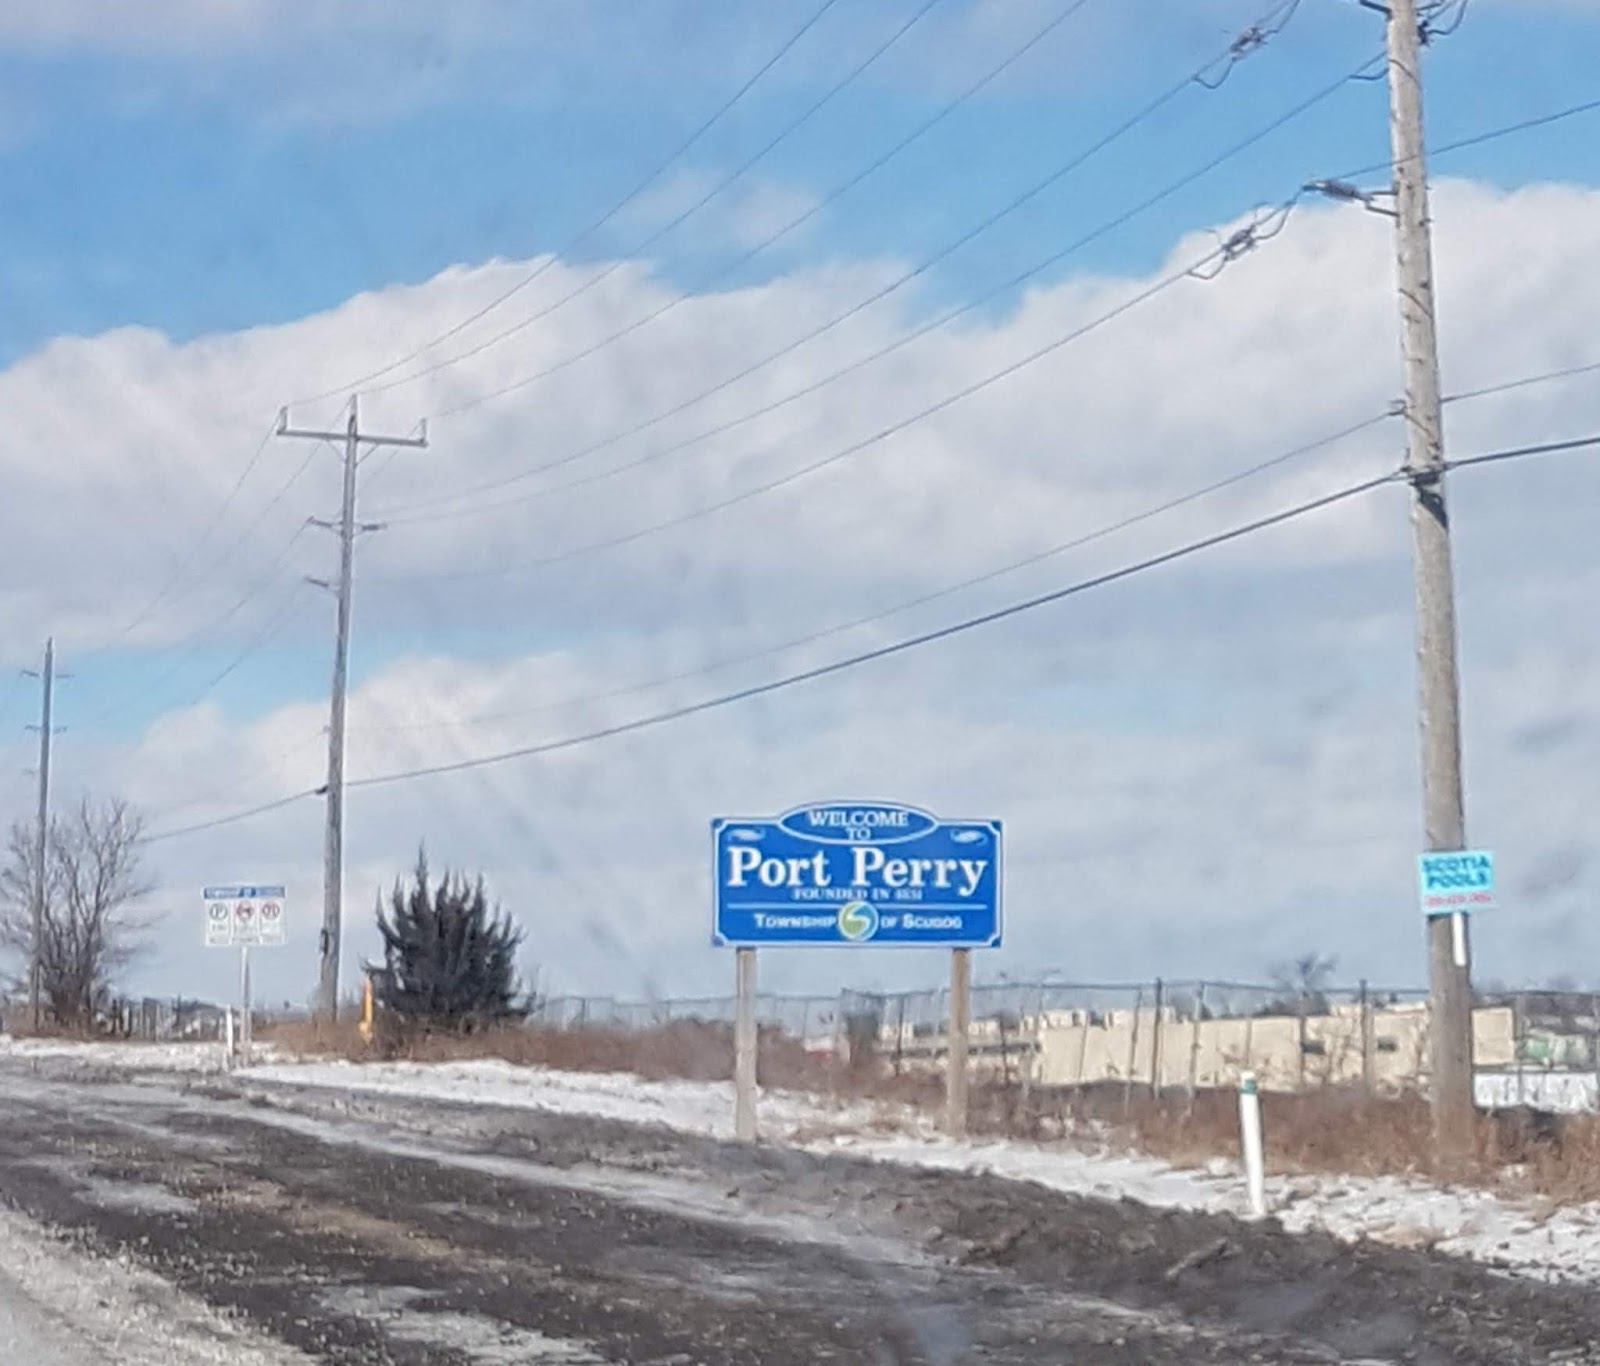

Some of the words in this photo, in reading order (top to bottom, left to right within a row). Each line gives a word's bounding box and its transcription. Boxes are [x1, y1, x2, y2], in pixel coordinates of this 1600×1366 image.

[808, 810, 909, 827] WELCOME
[846, 827, 871, 840] TO
[727, 846, 832, 887] Port
[852, 846, 988, 897] Perry
